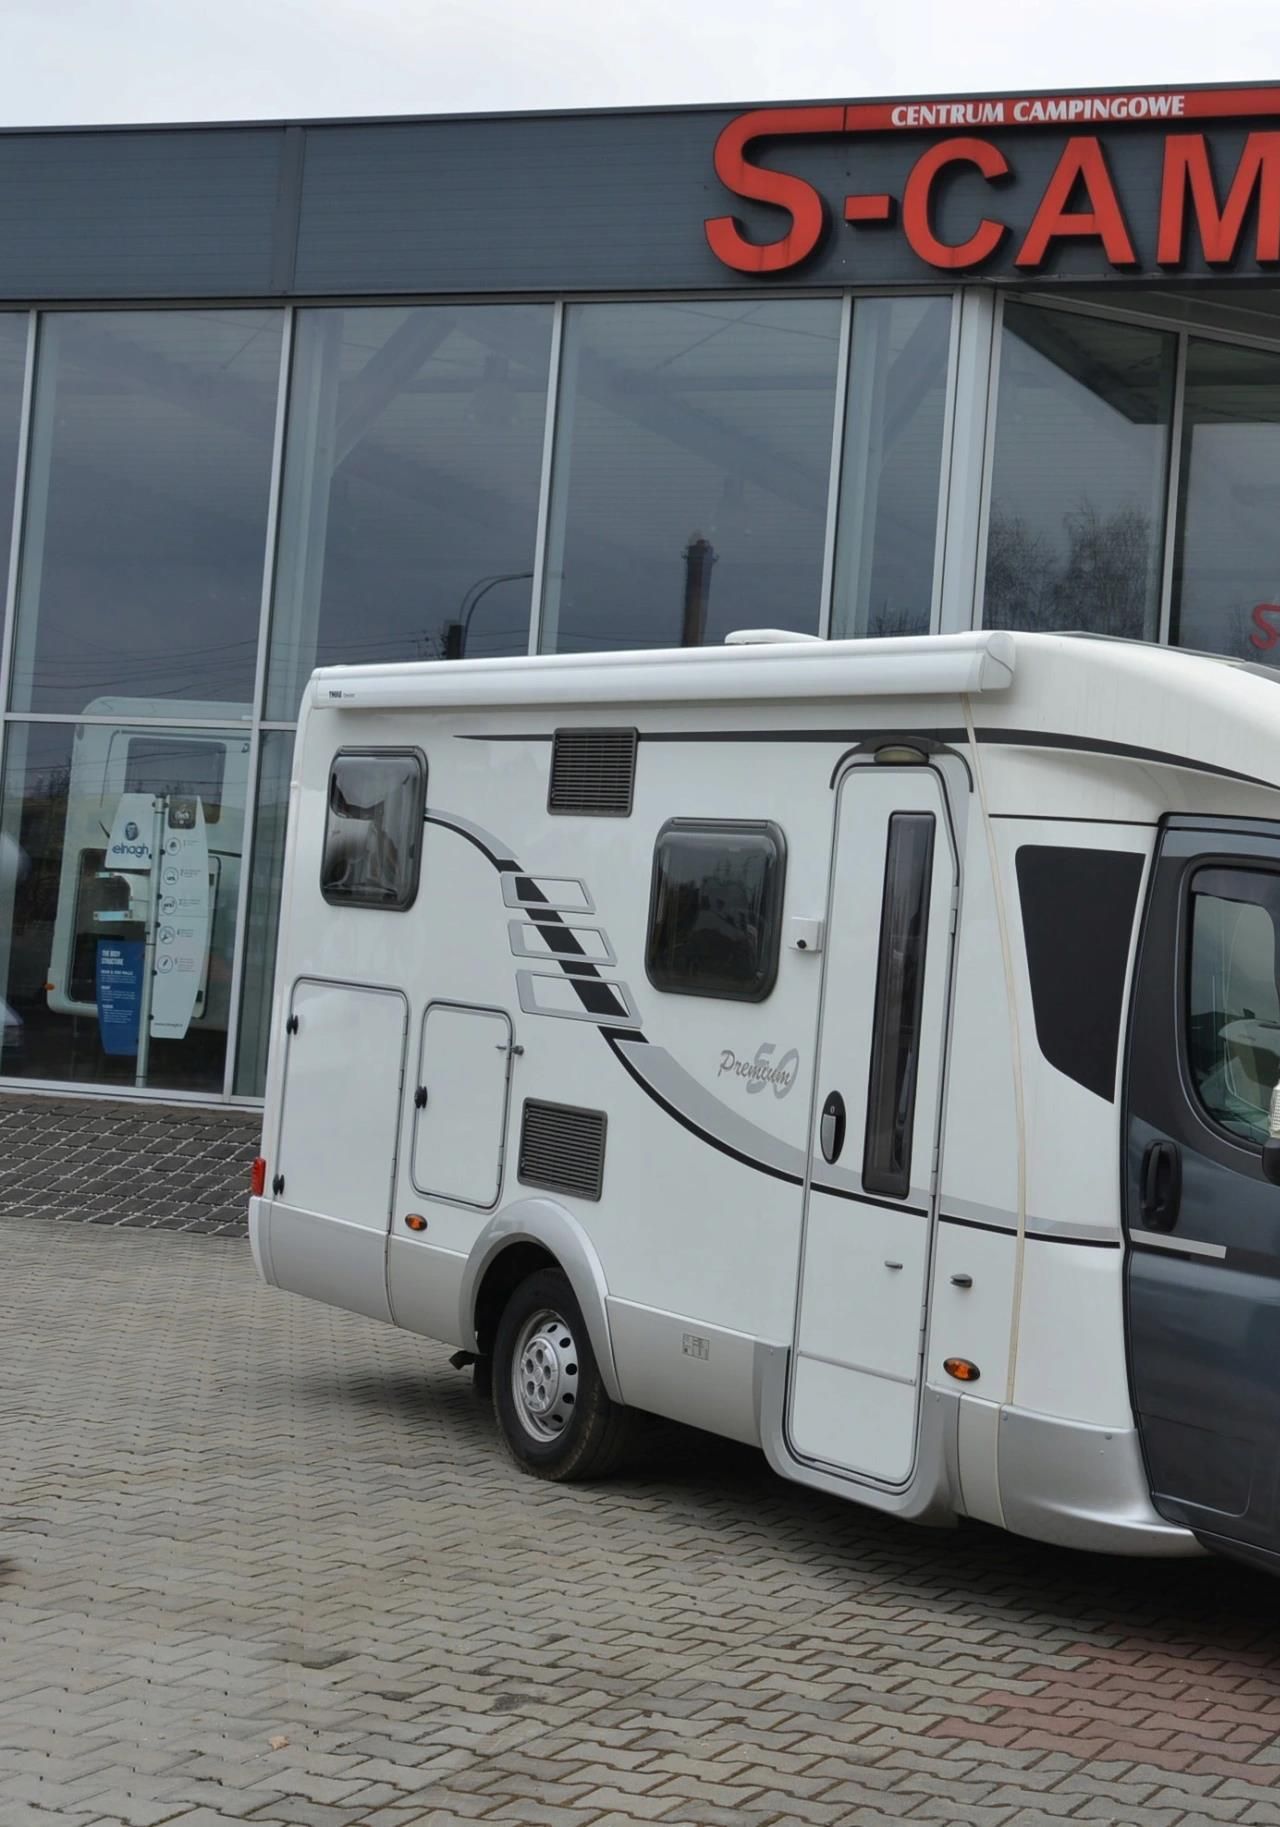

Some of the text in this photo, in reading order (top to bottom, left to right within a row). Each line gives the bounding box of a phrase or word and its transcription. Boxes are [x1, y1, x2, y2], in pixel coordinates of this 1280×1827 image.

[890, 96, 1185, 126] CENTRUM CAMPINGOWE
[112, 842, 149, 858] elnagh
[717, 1042, 799, 1100] Premium 50
